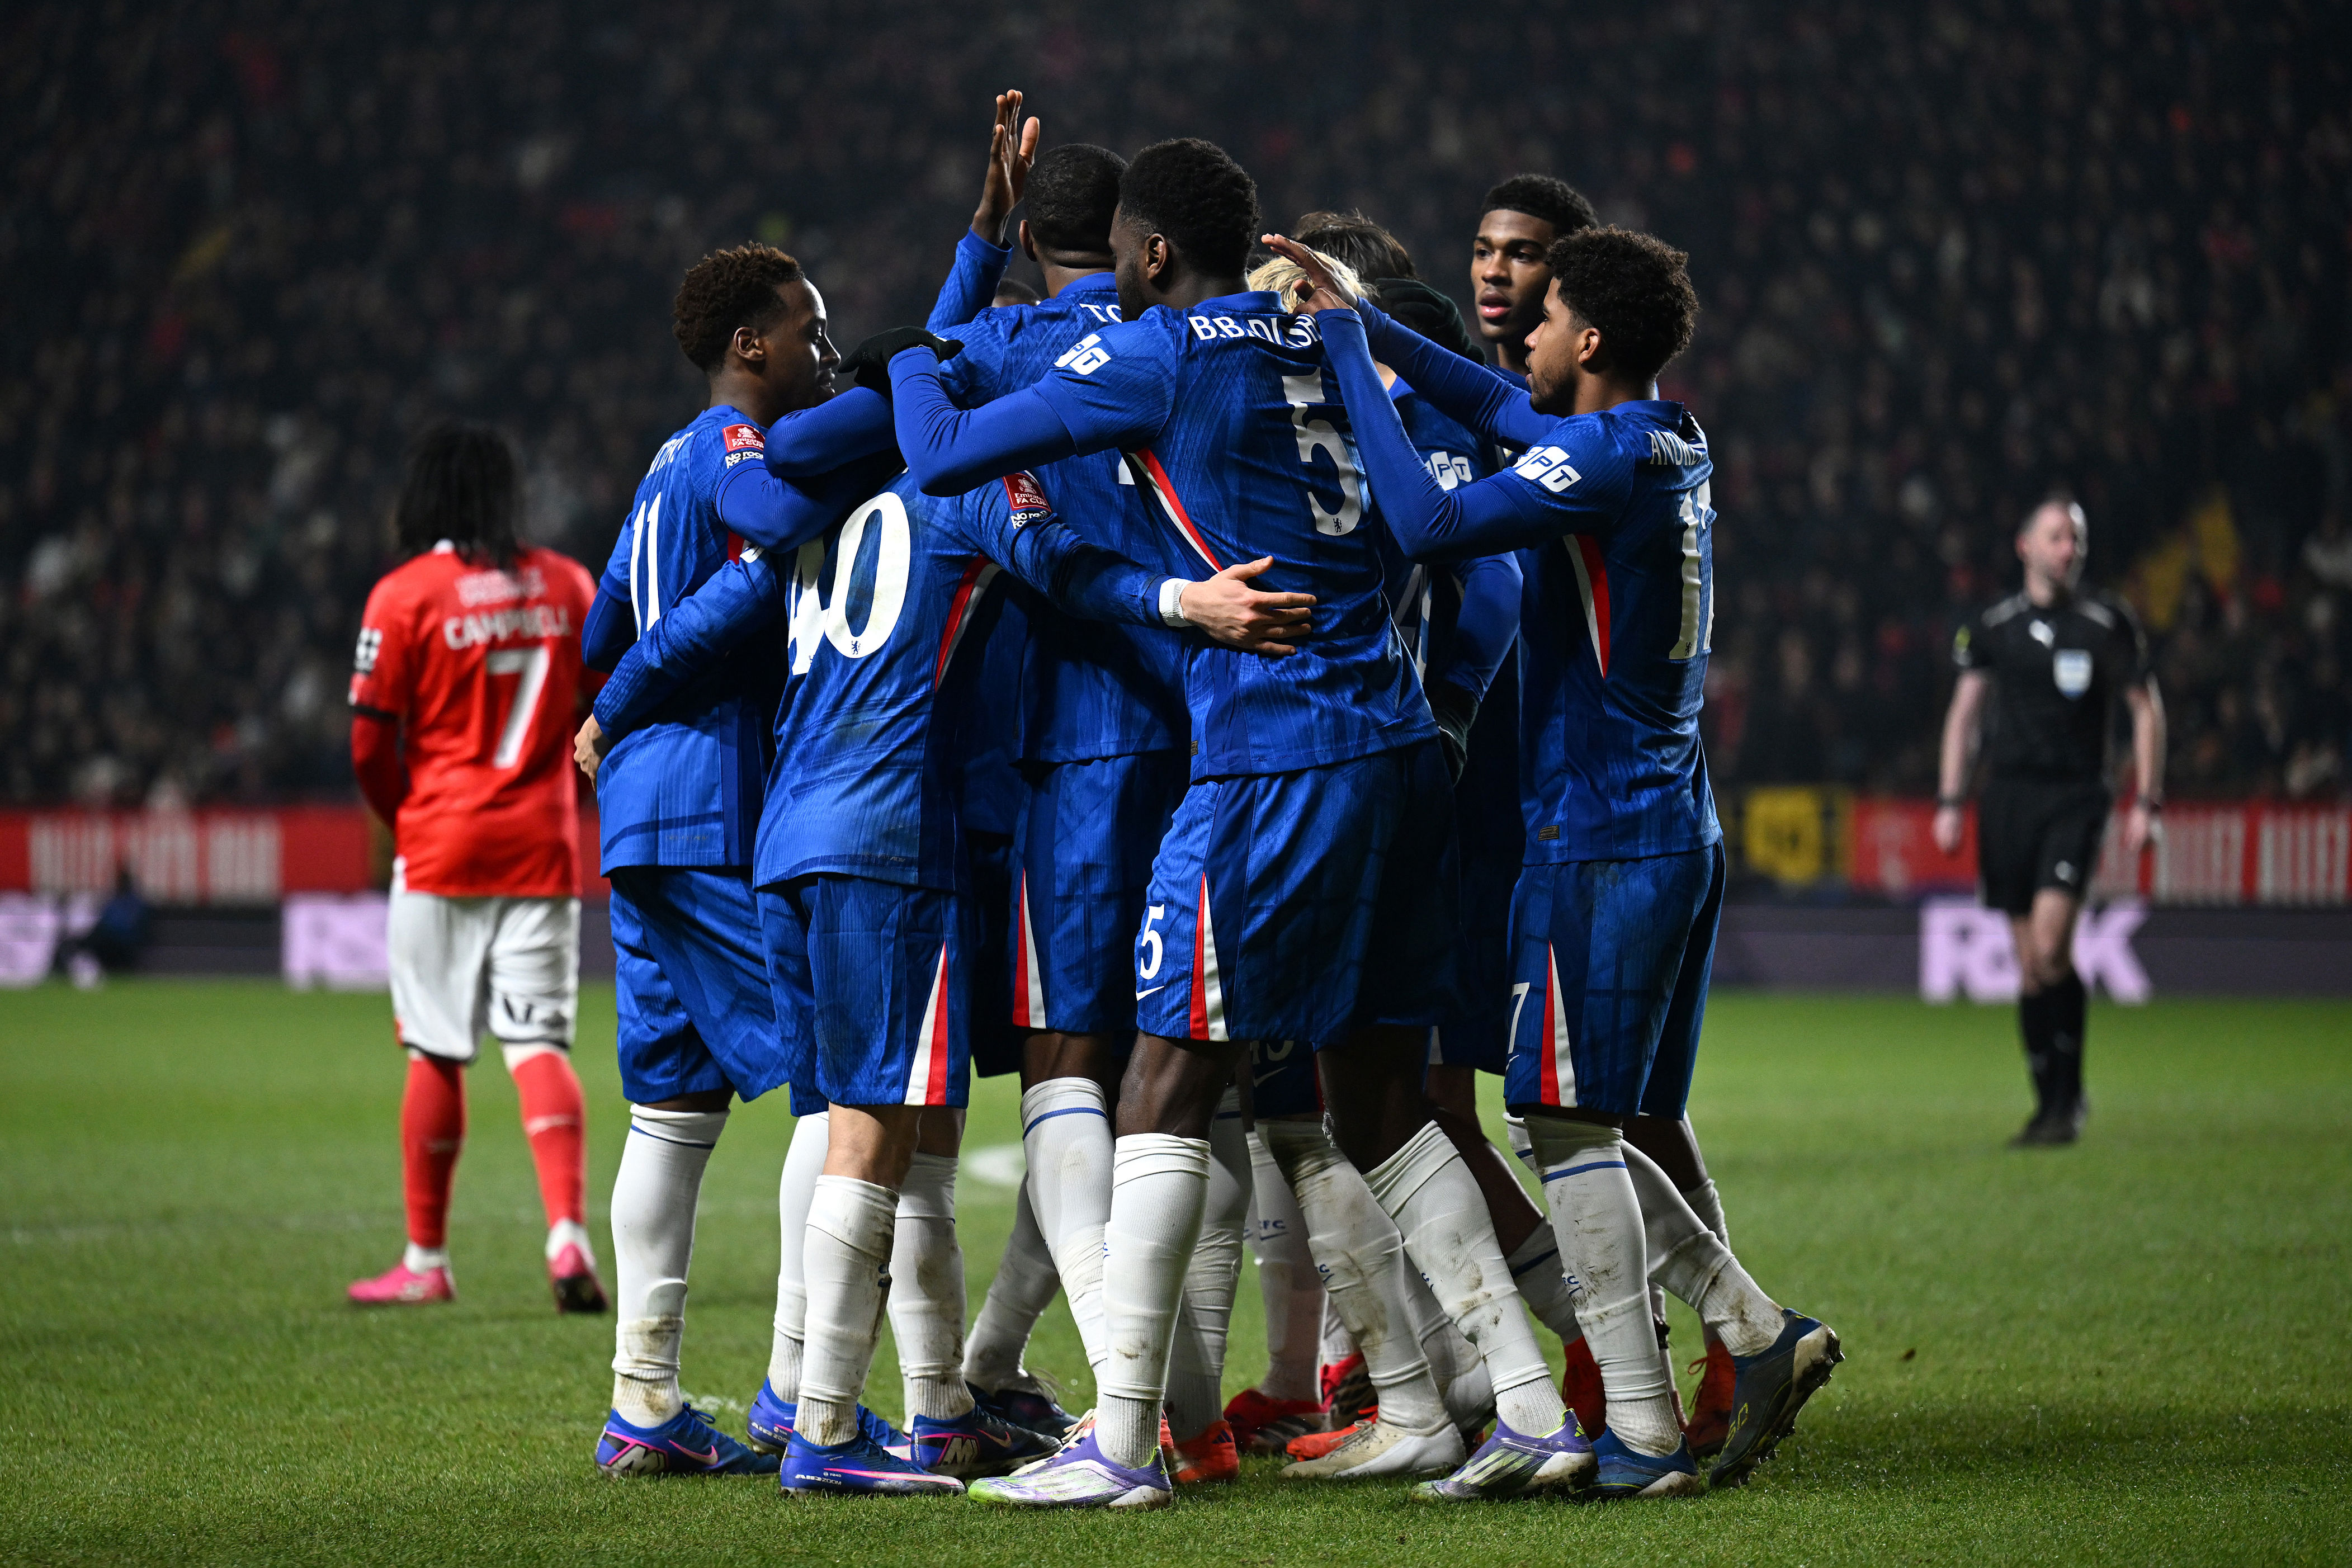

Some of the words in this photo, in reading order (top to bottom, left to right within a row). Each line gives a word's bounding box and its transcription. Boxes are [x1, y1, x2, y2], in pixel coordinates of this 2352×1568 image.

[1282, 367, 1361, 536] 5
[1512, 446, 1582, 492] PT
[630, 492, 661, 641] 11
[787, 492, 910, 676] 40
[443, 605, 572, 649] CAMPBELL
[485, 644, 550, 769] 7
[1140, 904, 1165, 980] 5
[773, 1433, 790, 1443] ZOO
[821, 1477, 842, 1486] ZOOM
